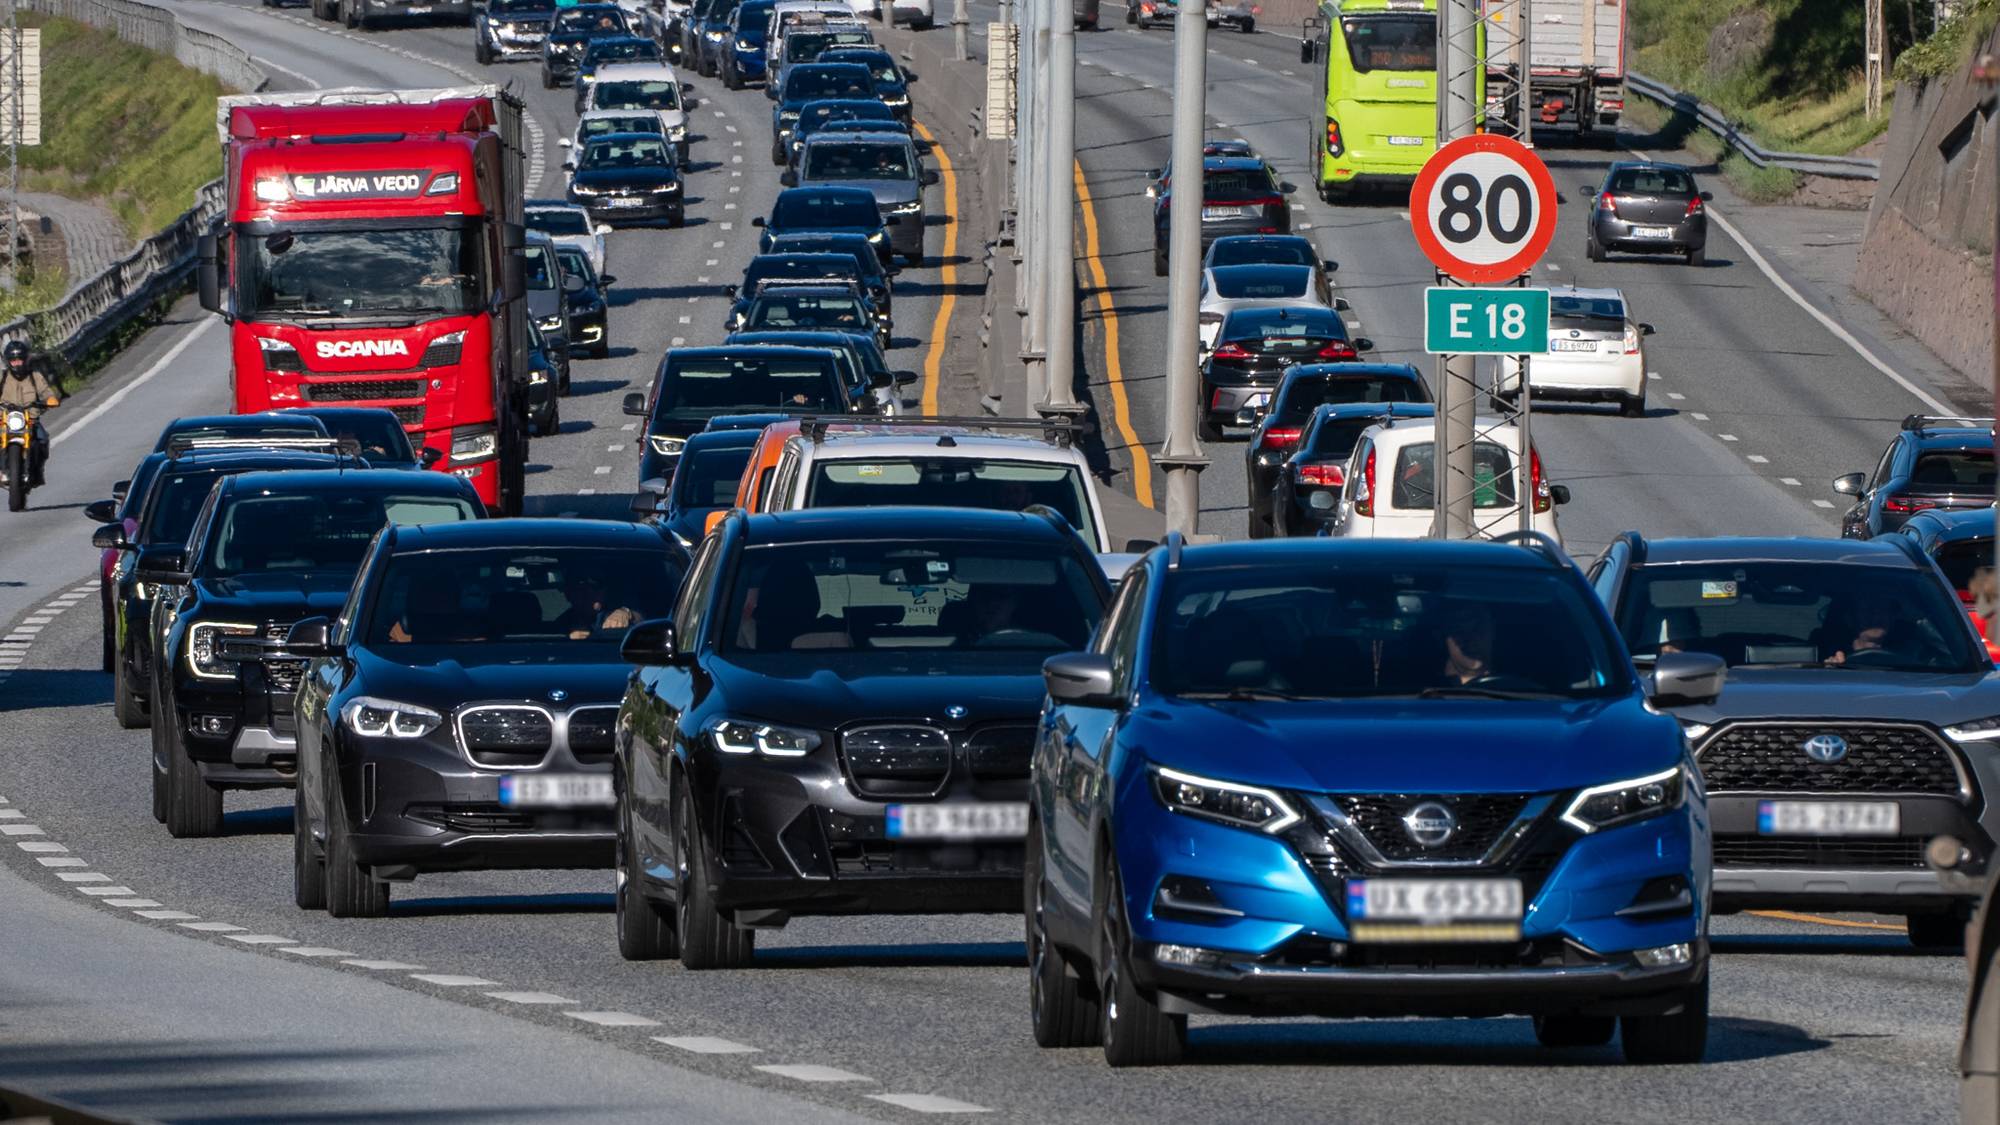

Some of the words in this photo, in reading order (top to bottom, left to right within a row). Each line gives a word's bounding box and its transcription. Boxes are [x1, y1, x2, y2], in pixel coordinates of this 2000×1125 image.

[316, 175, 369, 193] JÄRVA
[373, 174, 420, 192] VEOD
[1438, 172, 1532, 244] 80
[1450, 303, 1473, 339] E
[1485, 302, 1526, 340] 18
[315, 339, 410, 358] SCANIA
